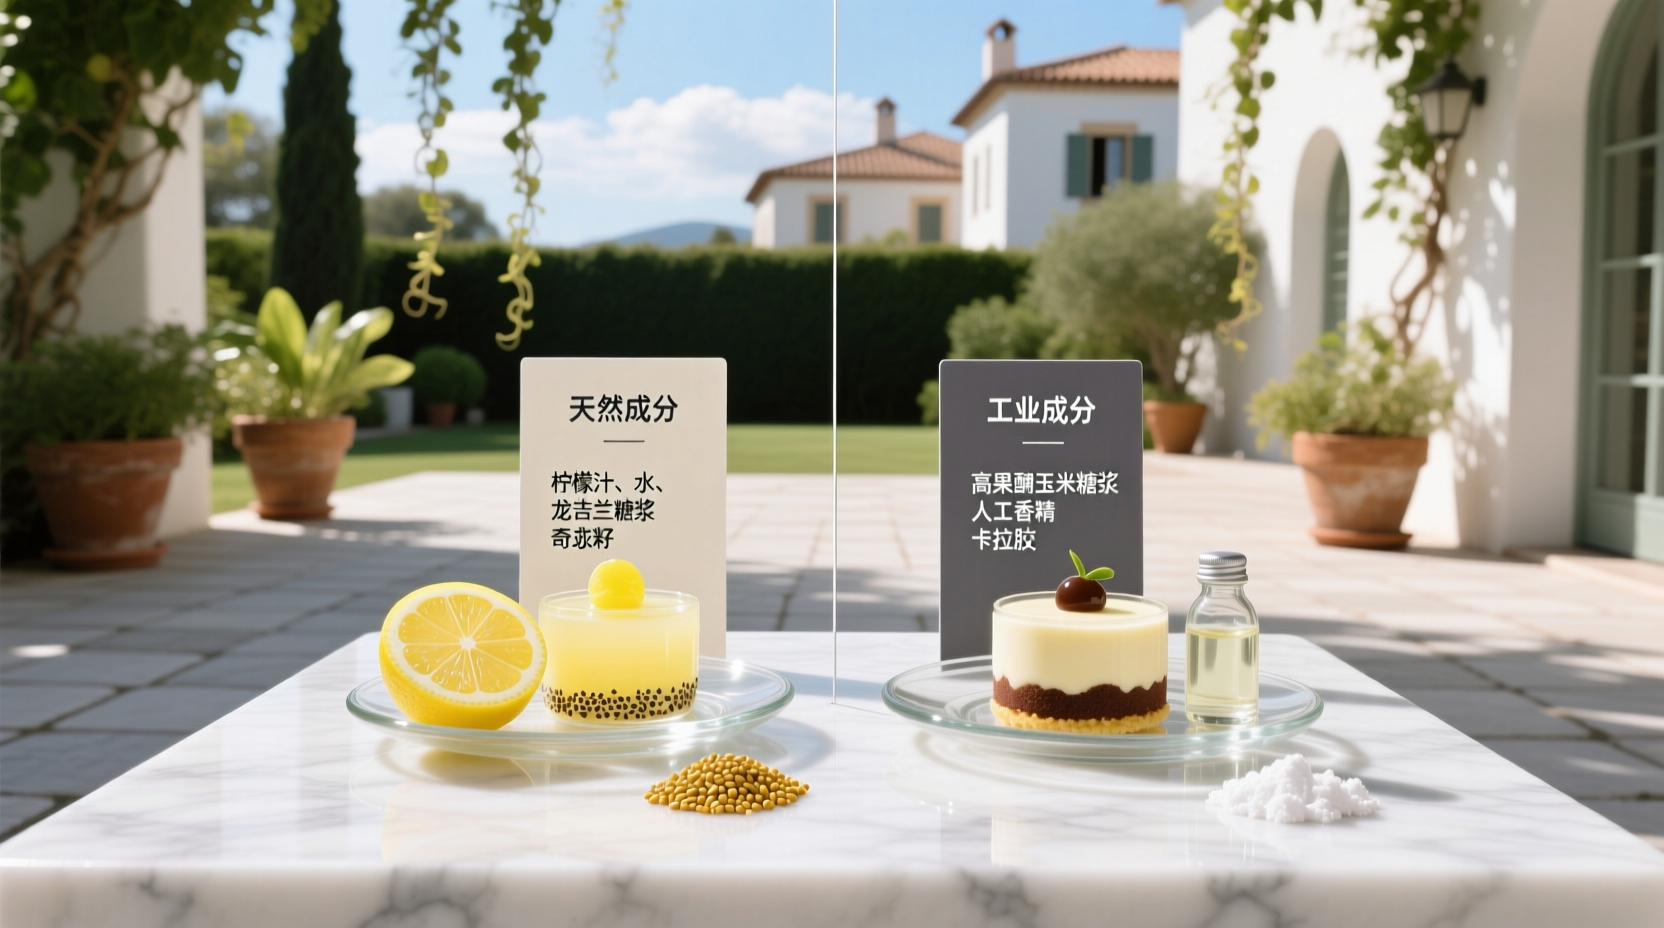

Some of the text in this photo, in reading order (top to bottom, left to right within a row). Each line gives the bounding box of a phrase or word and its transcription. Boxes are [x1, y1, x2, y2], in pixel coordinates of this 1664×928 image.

[569, 393, 679, 424] 天然成分
[986, 394, 1096, 426] 工业成分
[971, 499, 1056, 523] 人工香精
[971, 526, 1037, 552] 卡拉胶
